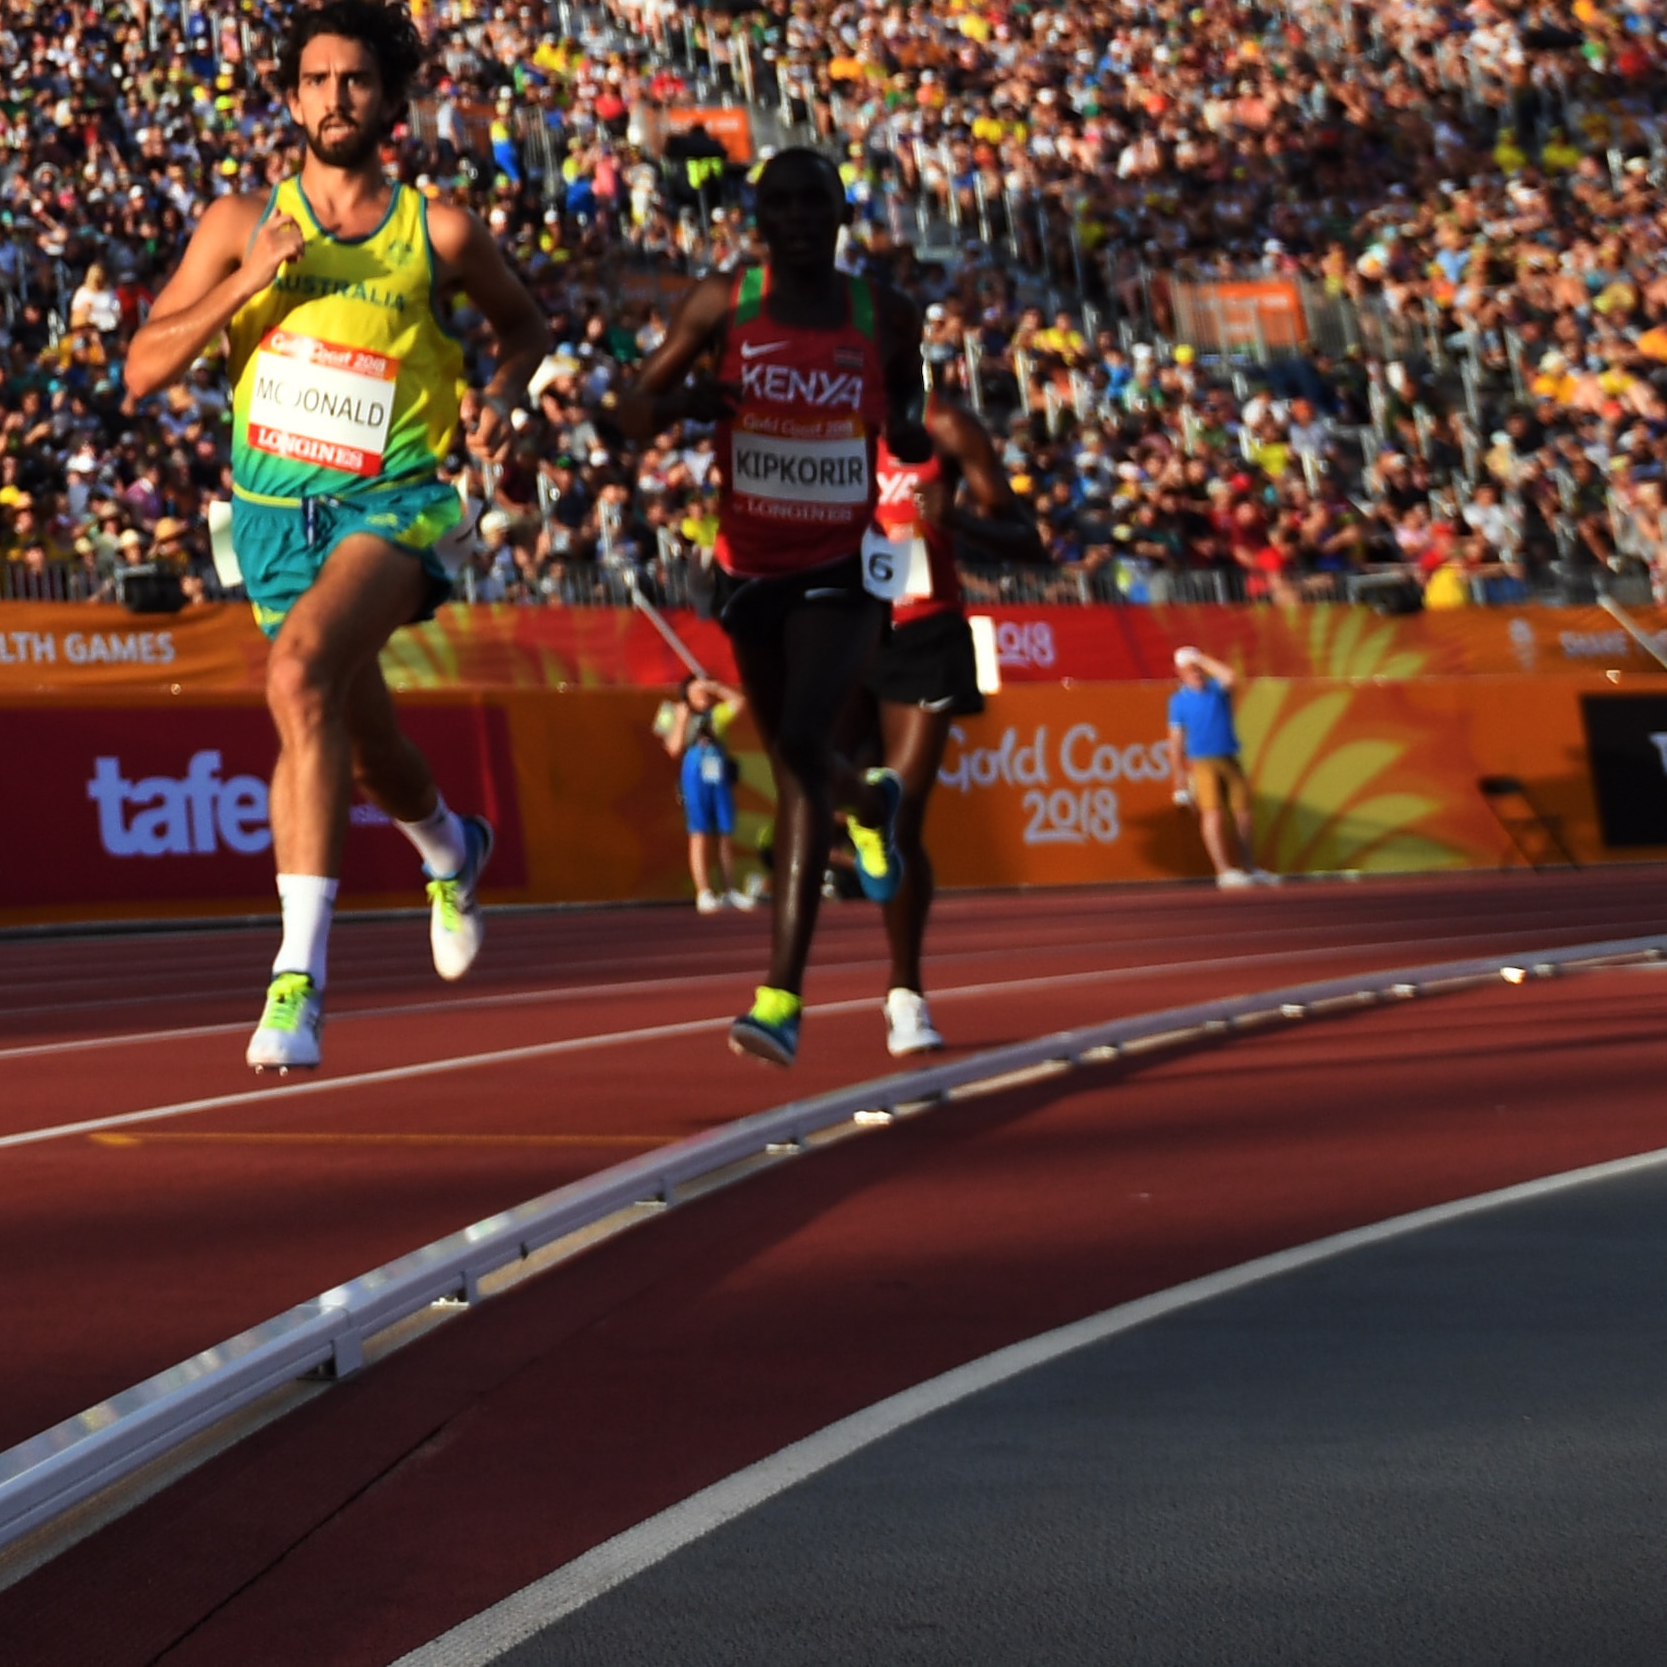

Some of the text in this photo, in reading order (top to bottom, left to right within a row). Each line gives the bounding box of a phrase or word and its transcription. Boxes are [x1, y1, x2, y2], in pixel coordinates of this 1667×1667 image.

[273, 275, 406, 311] AUSTRALIA
[741, 363, 863, 411] KENYA
[258, 428, 364, 469] LONGINES
[736, 450, 863, 485] KIPKORIR
[868, 553, 894, 582] 6
[64, 630, 176, 663] GAMES
[997, 621, 1056, 669] 018
[1061, 723, 1173, 782] Coas
[87, 749, 273, 857] tafe
[1023, 787, 1120, 845] 2018
